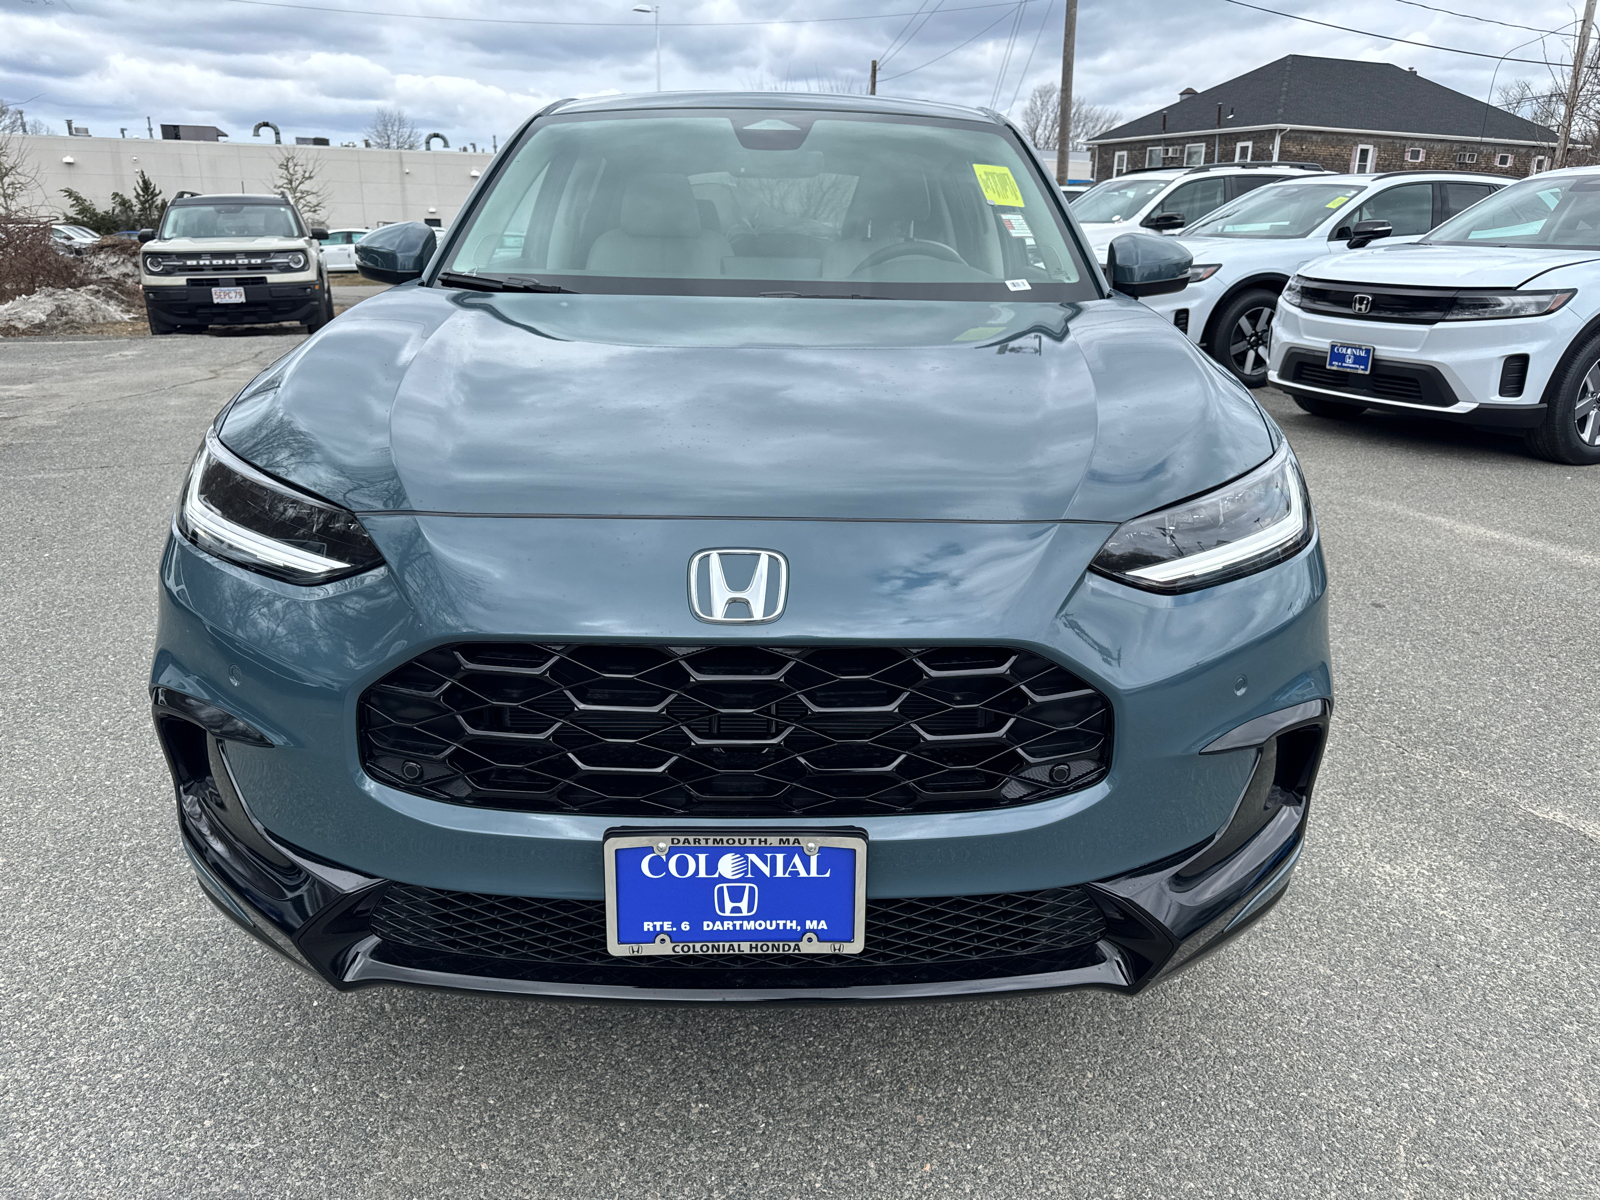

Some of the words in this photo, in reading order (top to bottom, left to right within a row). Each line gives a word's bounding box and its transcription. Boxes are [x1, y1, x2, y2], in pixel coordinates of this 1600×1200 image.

[779, 837, 802, 846] MA
[640, 852, 831, 879] COLONIAL
[643, 922, 677, 932] RTE.
[680, 922, 690, 932] 6
[702, 920, 801, 932] DARTMOUTH,
[805, 920, 828, 930] MA
[671, 944, 745, 954] COLONIAL
[750, 943, 802, 953] HONDA
